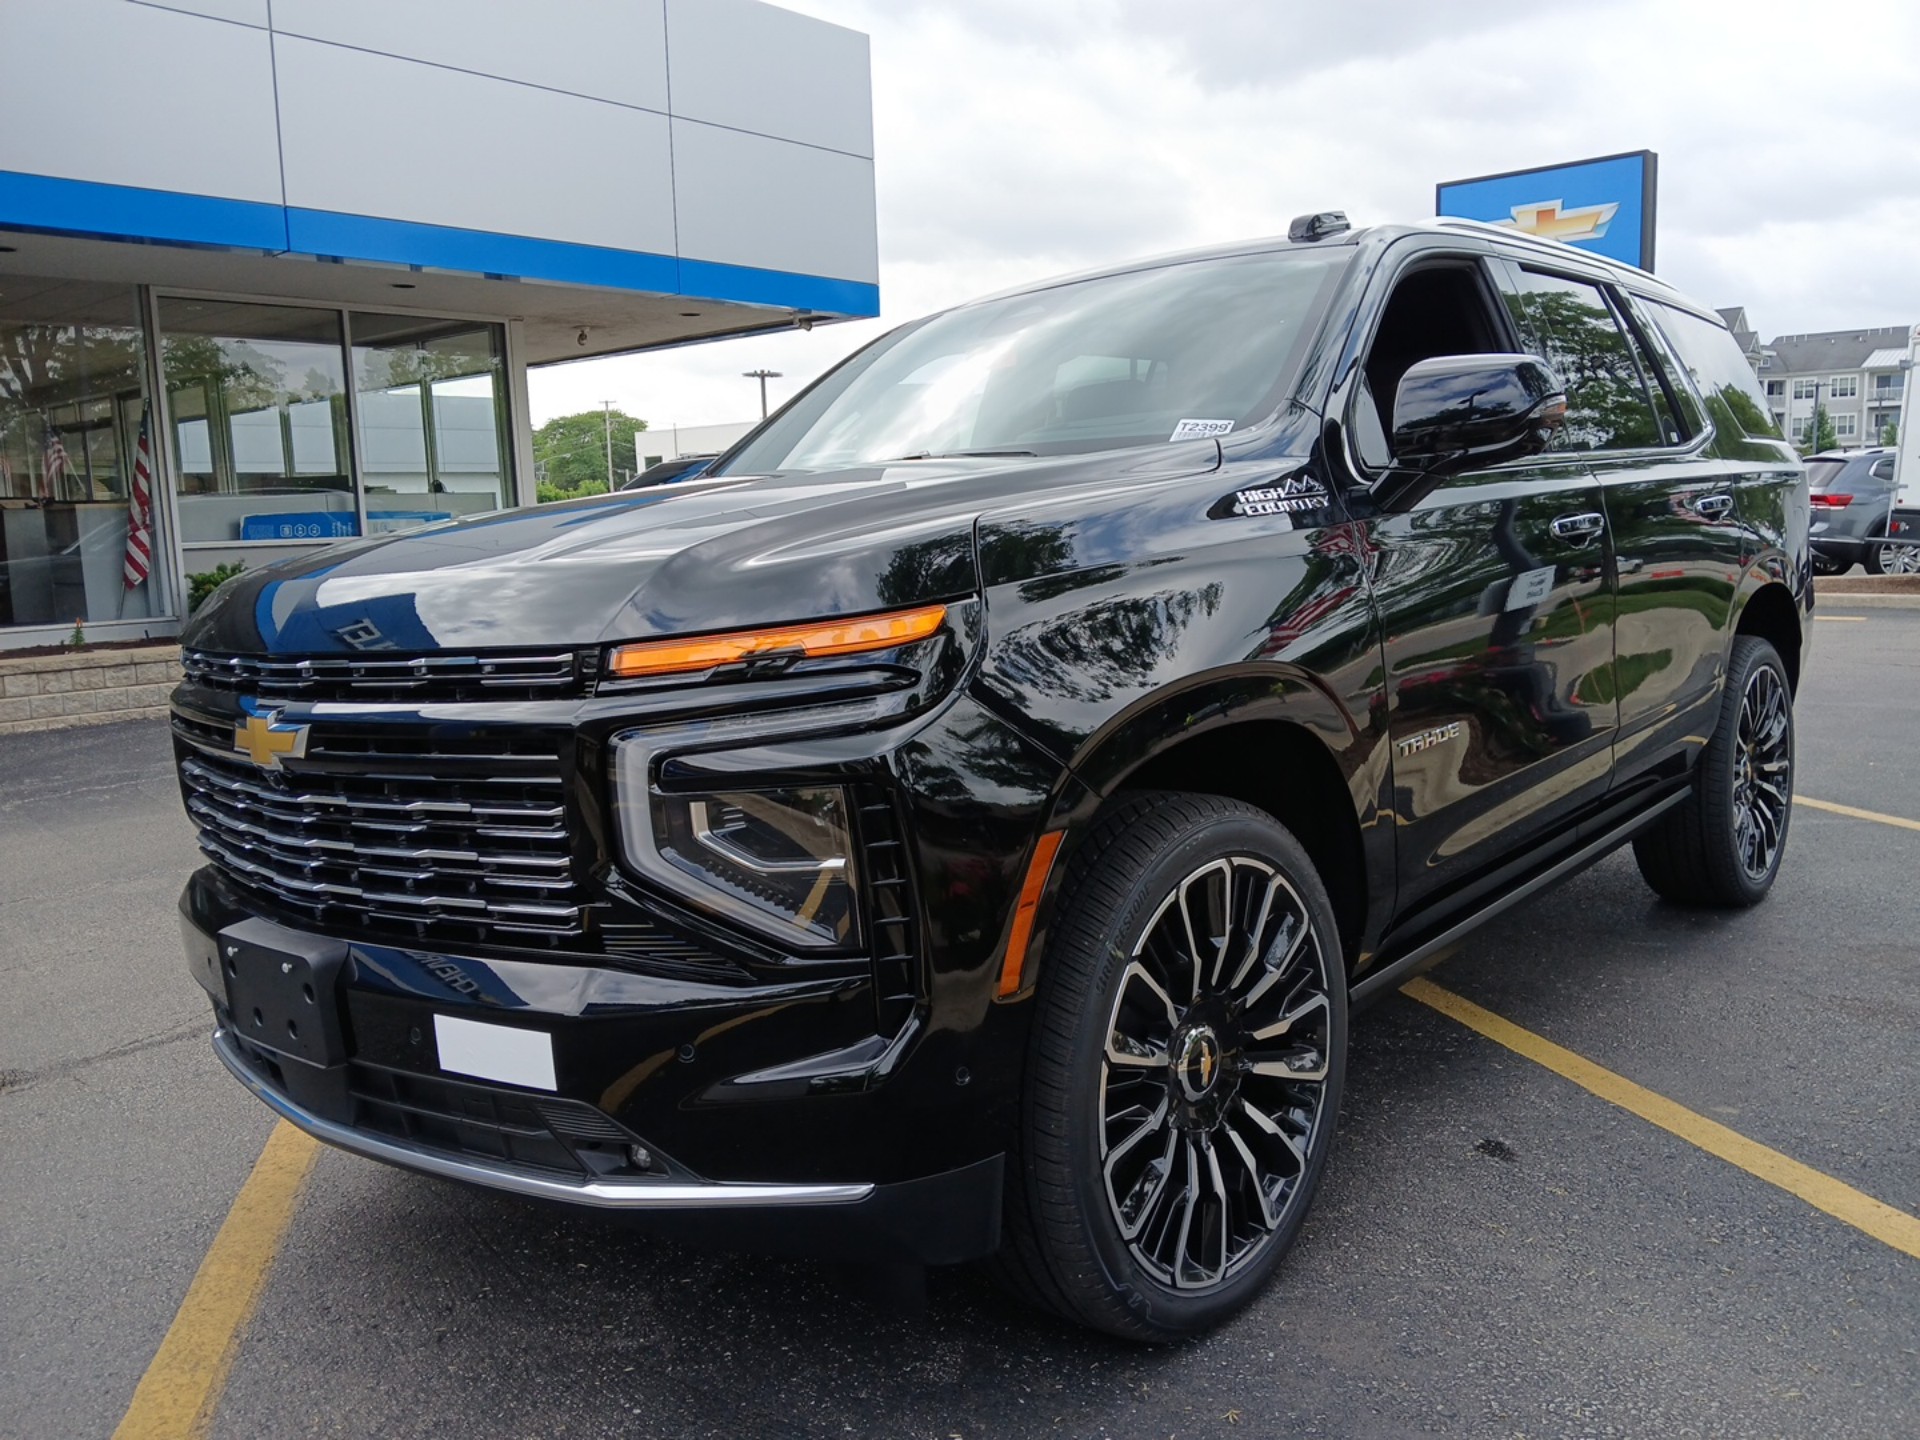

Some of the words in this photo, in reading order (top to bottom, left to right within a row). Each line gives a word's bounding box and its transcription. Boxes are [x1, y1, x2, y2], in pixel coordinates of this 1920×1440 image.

[1180, 421, 1229, 433] T2399
[1236, 488, 1285, 504] HIGH
[1243, 496, 1329, 516] COUNTRY
[1399, 721, 1460, 757] TAHOE
